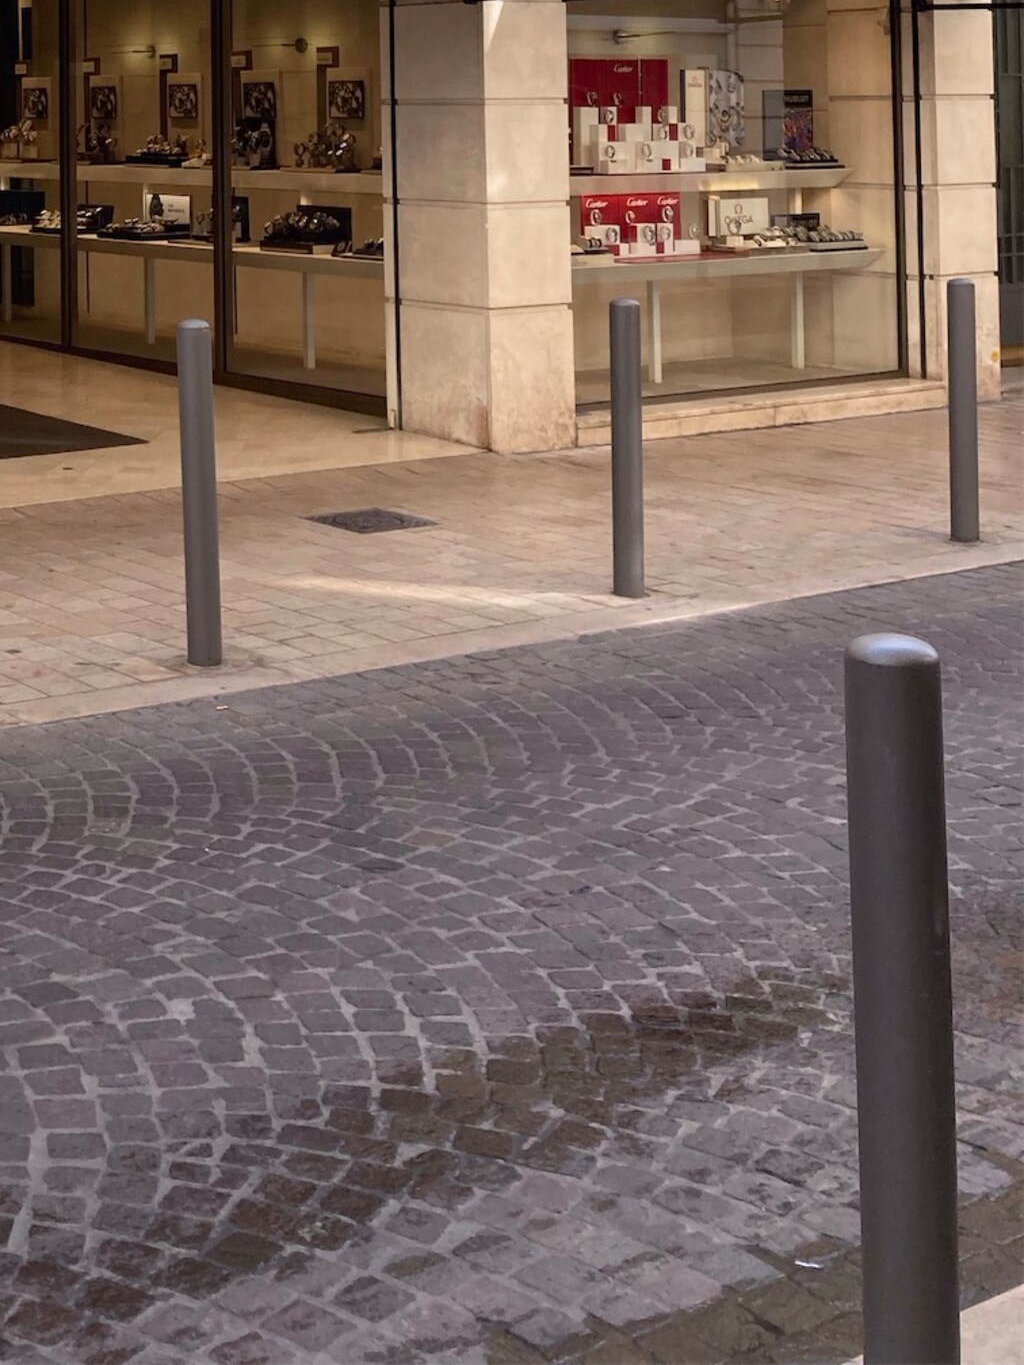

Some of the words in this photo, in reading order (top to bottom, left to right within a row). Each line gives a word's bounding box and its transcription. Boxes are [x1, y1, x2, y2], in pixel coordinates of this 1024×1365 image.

[613, 64, 634, 74] Cartier
[585, 198, 608, 208] Cartier
[626, 197, 648, 207] Cartier
[657, 196, 679, 205] Cartier
